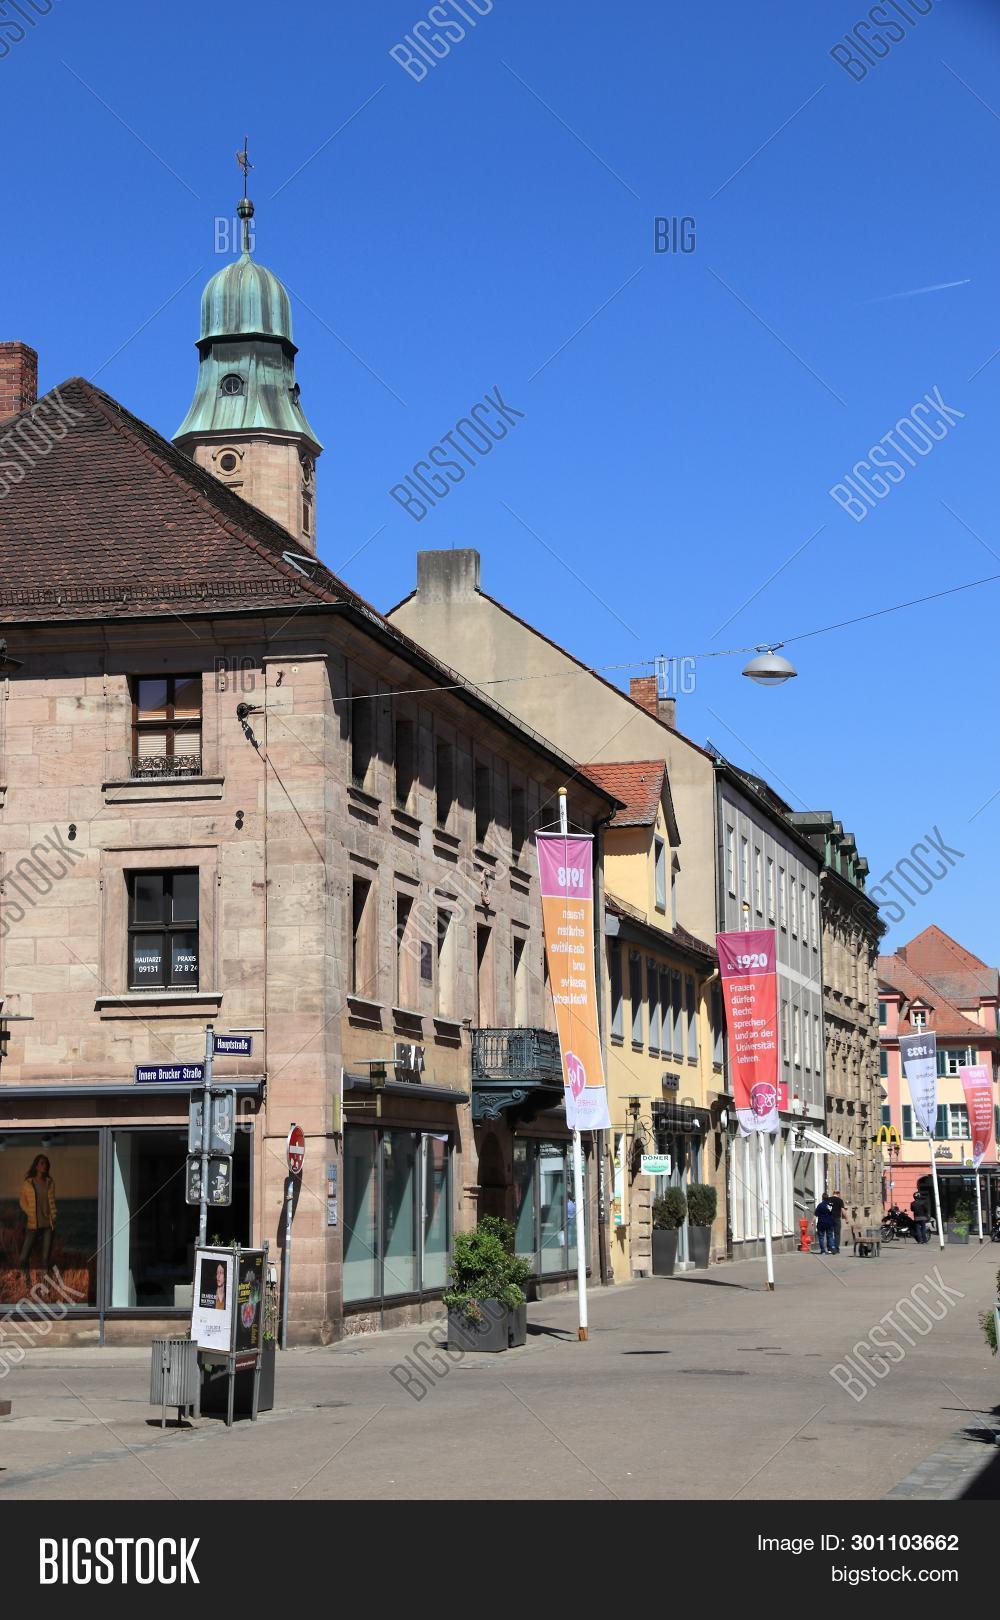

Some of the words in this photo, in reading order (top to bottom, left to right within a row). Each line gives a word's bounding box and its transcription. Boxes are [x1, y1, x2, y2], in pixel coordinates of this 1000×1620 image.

[134, 956, 162, 964] HAUTARZT
[736, 953, 768, 969] 1920
[138, 965, 158, 973] 09131
[174, 964, 183, 972] 22
[184, 964, 189, 972] 8
[729, 983, 755, 993] Frauen
[731, 995, 755, 1005] dürfen
[733, 1019, 766, 1030] sprechen
[735, 1032, 749, 1040] und
[760, 1029, 774, 1038] der
[217, 1038, 248, 1052] Hauptstraße
[736, 1041, 776, 1053] Universität
[138, 1069, 157, 1081] Innere
[158, 1068, 181, 1080] Brucker
[182, 1067, 202, 1079] Straße
